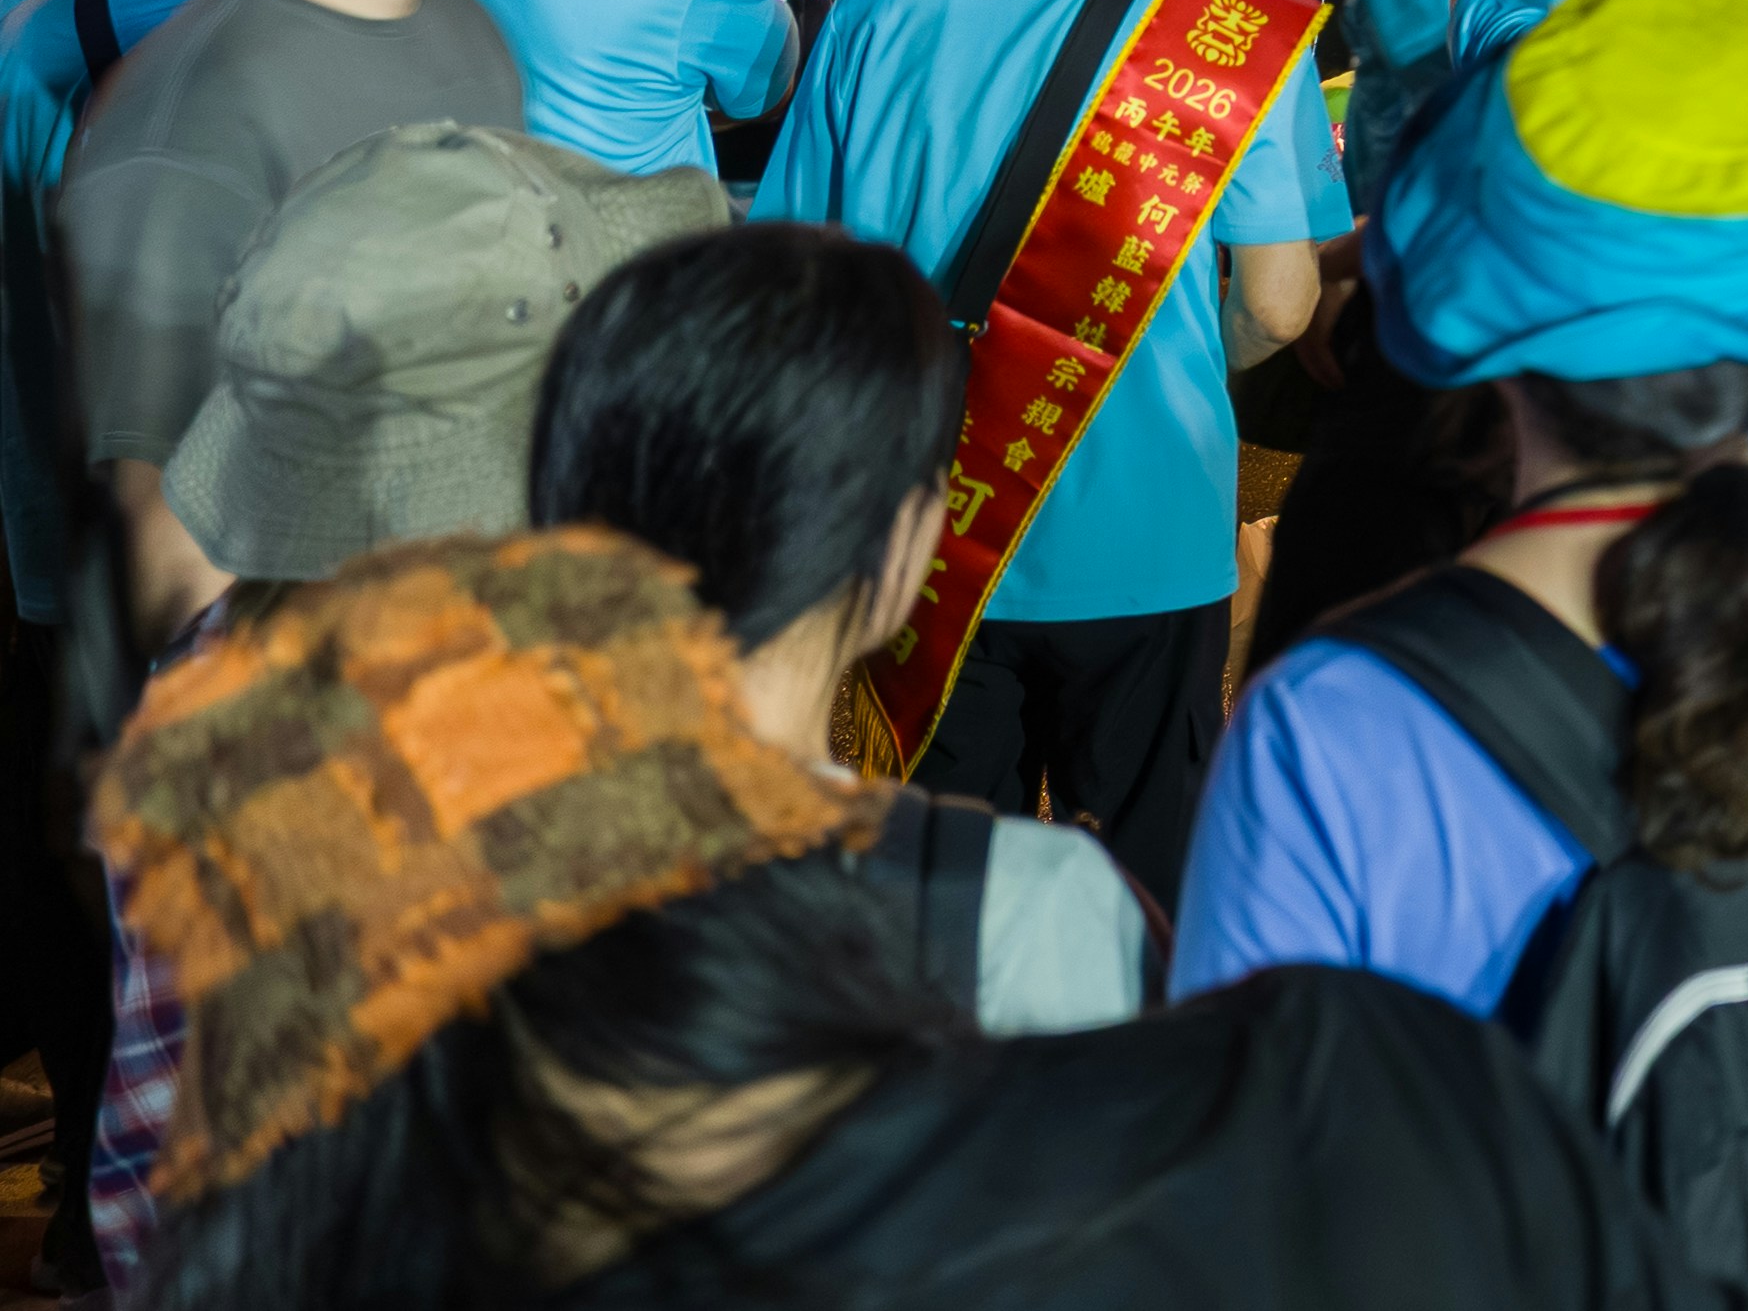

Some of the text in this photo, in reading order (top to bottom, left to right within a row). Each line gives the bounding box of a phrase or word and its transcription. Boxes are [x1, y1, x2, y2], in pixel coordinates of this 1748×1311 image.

[1144, 58, 1237, 122] 2026
[1115, 97, 1215, 159] 丙午年
